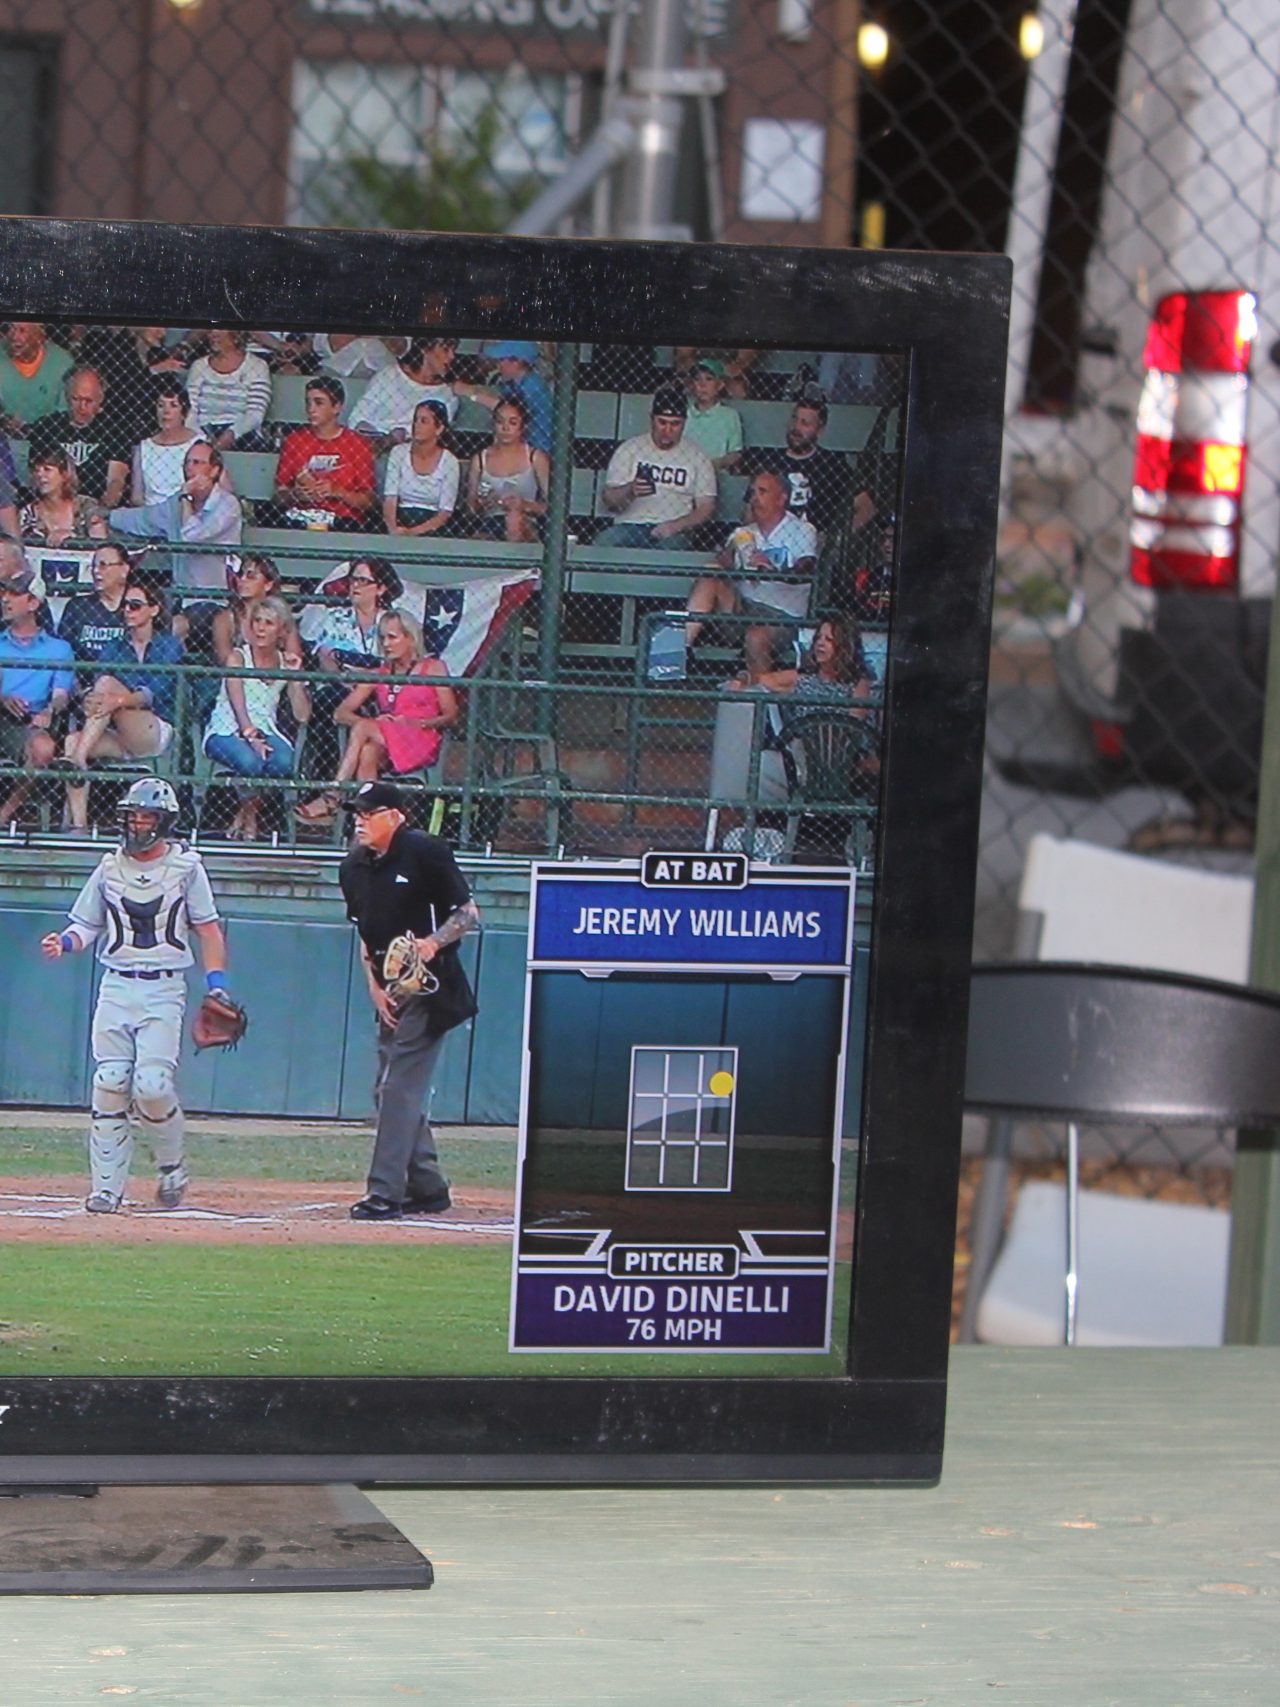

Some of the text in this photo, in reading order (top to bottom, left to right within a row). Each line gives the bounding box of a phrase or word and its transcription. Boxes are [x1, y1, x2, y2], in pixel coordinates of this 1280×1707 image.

[653, 860, 738, 882] AT BAT
[572, 907, 822, 938] JEREMY WILLIAMS
[624, 1252, 725, 1273] PITCHER
[553, 1285, 790, 1313] DAVID DINELLI
[626, 1317, 723, 1341] 76 MPH
